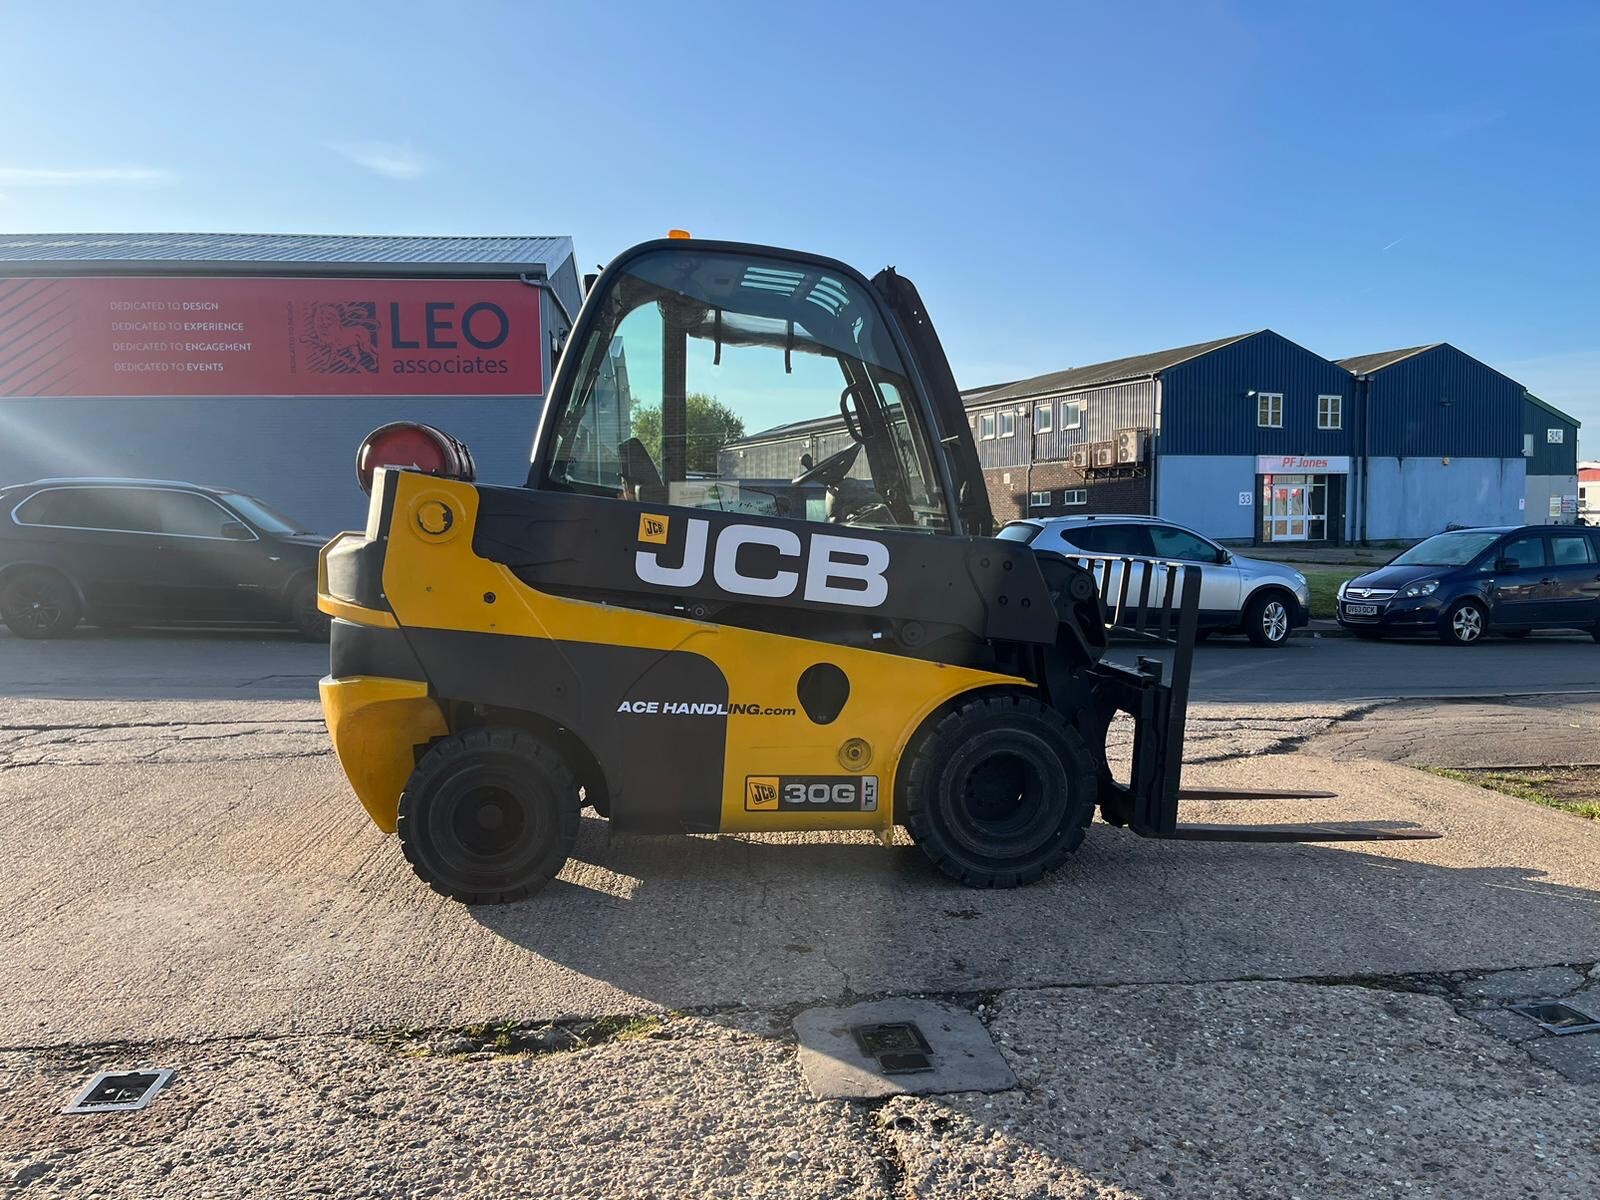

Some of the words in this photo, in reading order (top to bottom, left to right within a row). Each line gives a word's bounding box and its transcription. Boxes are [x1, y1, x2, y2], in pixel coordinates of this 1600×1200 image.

[110, 302, 165, 311] DEDICATED
[167, 302, 180, 310] TO
[182, 302, 219, 311] DESIGN
[111, 322, 166, 331] DEDICATED
[168, 322, 182, 331] TO
[184, 322, 245, 331] EXPERIENCE
[390, 302, 509, 349] LEO
[112, 342, 168, 351] DEDICATED
[170, 342, 184, 351] TO
[185, 342, 252, 352] ENGAGEMENT
[114, 362, 169, 371] DEDICATED
[170, 362, 185, 371] TO
[186, 362, 225, 372] EVENTS
[393, 355, 508, 374] associates
[1282, 457, 1297, 468] PF
[1296, 457, 1328, 468] Jones
[1240, 494, 1251, 504] 33
[645, 518, 665, 536] JCB
[635, 518, 890, 608] JCB
[617, 701, 659, 714] ACE
[662, 702, 797, 716] HANDLING.com
[753, 783, 776, 804] JCB
[784, 783, 856, 804] 30G
[864, 781, 875, 806] TLT
